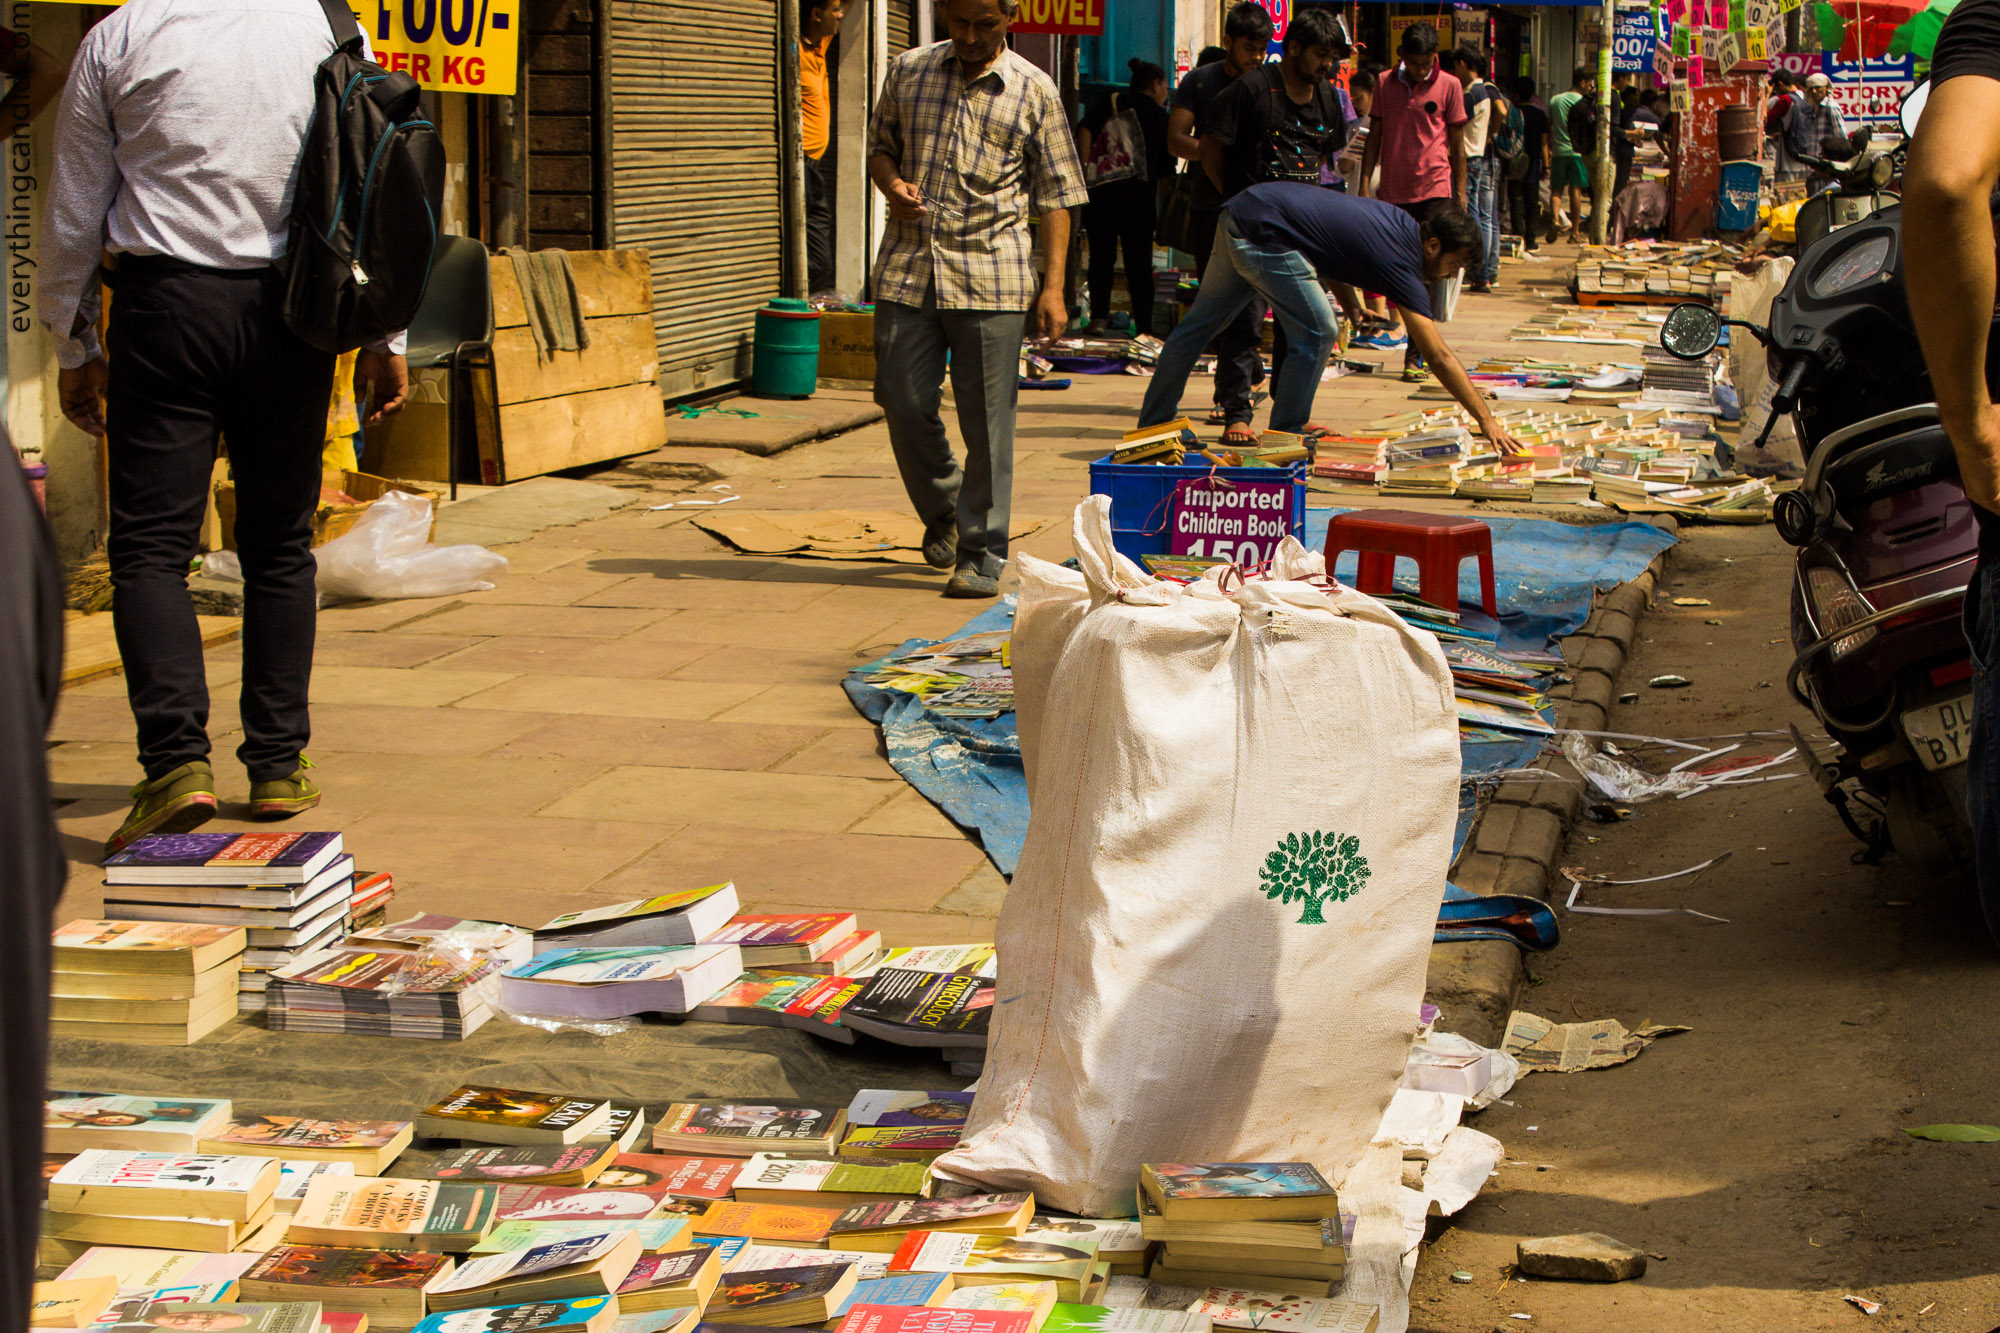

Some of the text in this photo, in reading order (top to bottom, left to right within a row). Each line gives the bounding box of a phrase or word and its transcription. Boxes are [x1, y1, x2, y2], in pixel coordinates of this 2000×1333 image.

[1013, 0, 1100, 26] NOVEL
[1614, 38, 1654, 56] 00/-
[1705, 42, 1714, 57] 10
[1751, 43, 1762, 58] 10
[1771, 33, 1781, 52] 10
[442, 56, 486, 86] KG
[1657, 58, 1668, 75] 10
[1723, 50, 1734, 68] 10
[1674, 95, 1684, 110] 10
[1832, 86, 1907, 99] STORY
[1183, 486, 1286, 513] Imported
[1178, 510, 1287, 537] Children Book
[1939, 701, 1972, 729] DL
[919, 976, 972, 1027] GYNECOLOGY
[439, 1090, 480, 1114] AMISH
[543, 1101, 596, 1126] RAM
[680, 1104, 696, 1119] PETER
[591, 1109, 632, 1136] RAM
[716, 1163, 735, 1175] THE
[757, 1163, 793, 1183] 2020
[666, 1177, 688, 1191] GIRL
[358, 1192, 380, 1225] PROFITS
[397, 1192, 414, 1222] STOCKS
[410, 1184, 431, 1221] COMMON
[949, 1237, 974, 1266] LEAN IN
[1316, 1302, 1348, 1328] DATTA
[1341, 1303, 1375, 1333] DURJO
